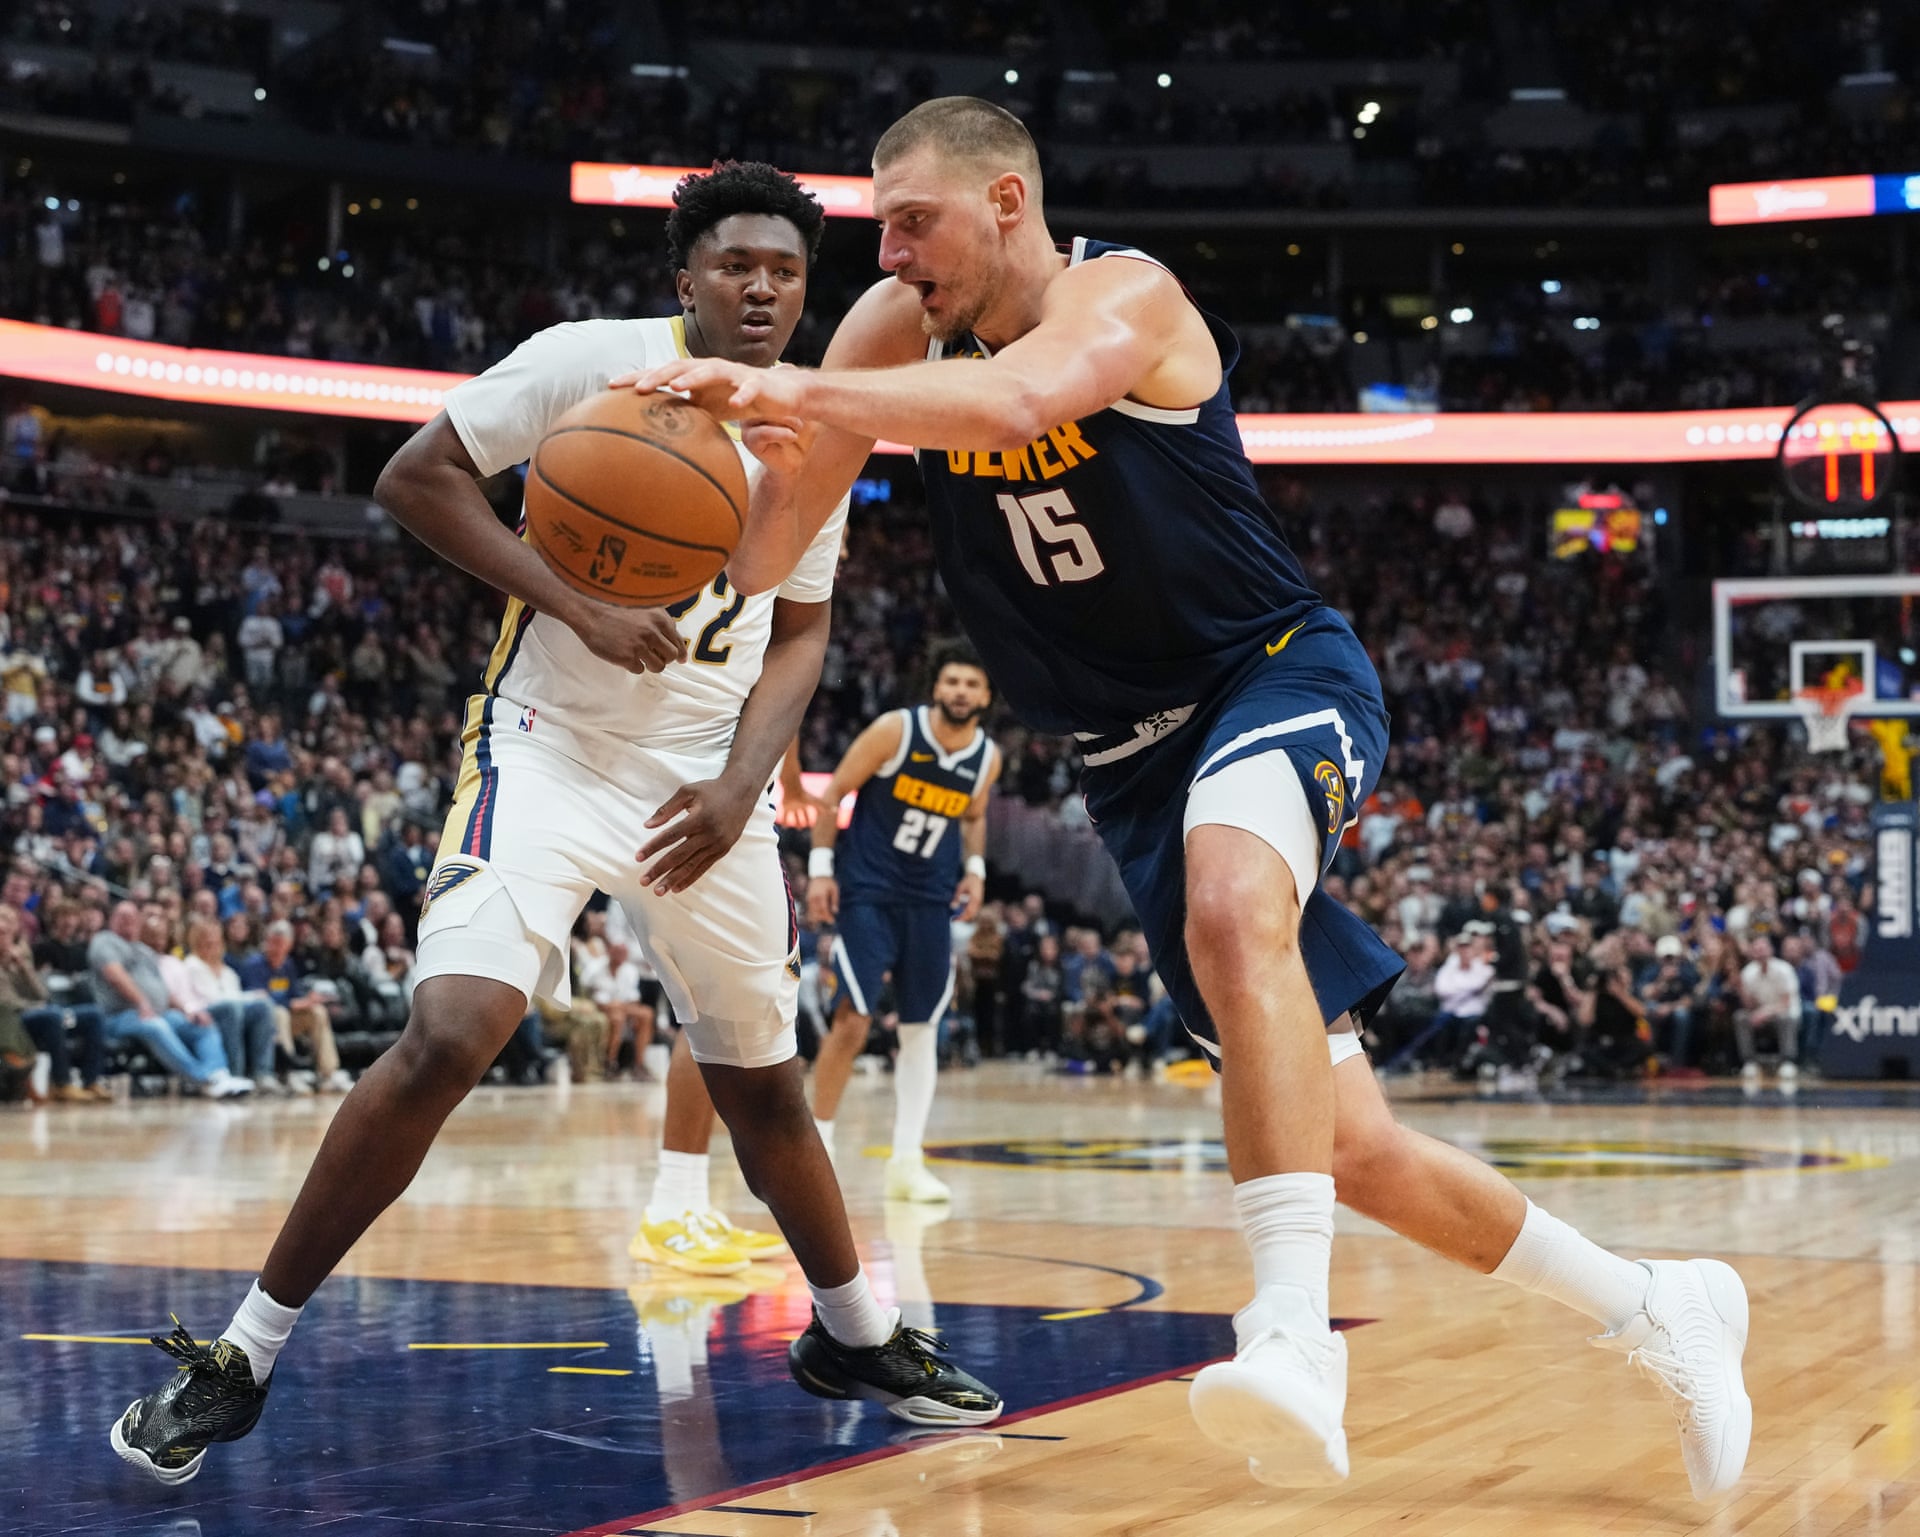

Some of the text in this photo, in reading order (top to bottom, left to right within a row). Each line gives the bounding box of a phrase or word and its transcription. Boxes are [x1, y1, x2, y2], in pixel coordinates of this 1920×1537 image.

[996, 487, 1105, 586] 15
[893, 772, 972, 818] DENVER
[893, 807, 949, 859] 27
